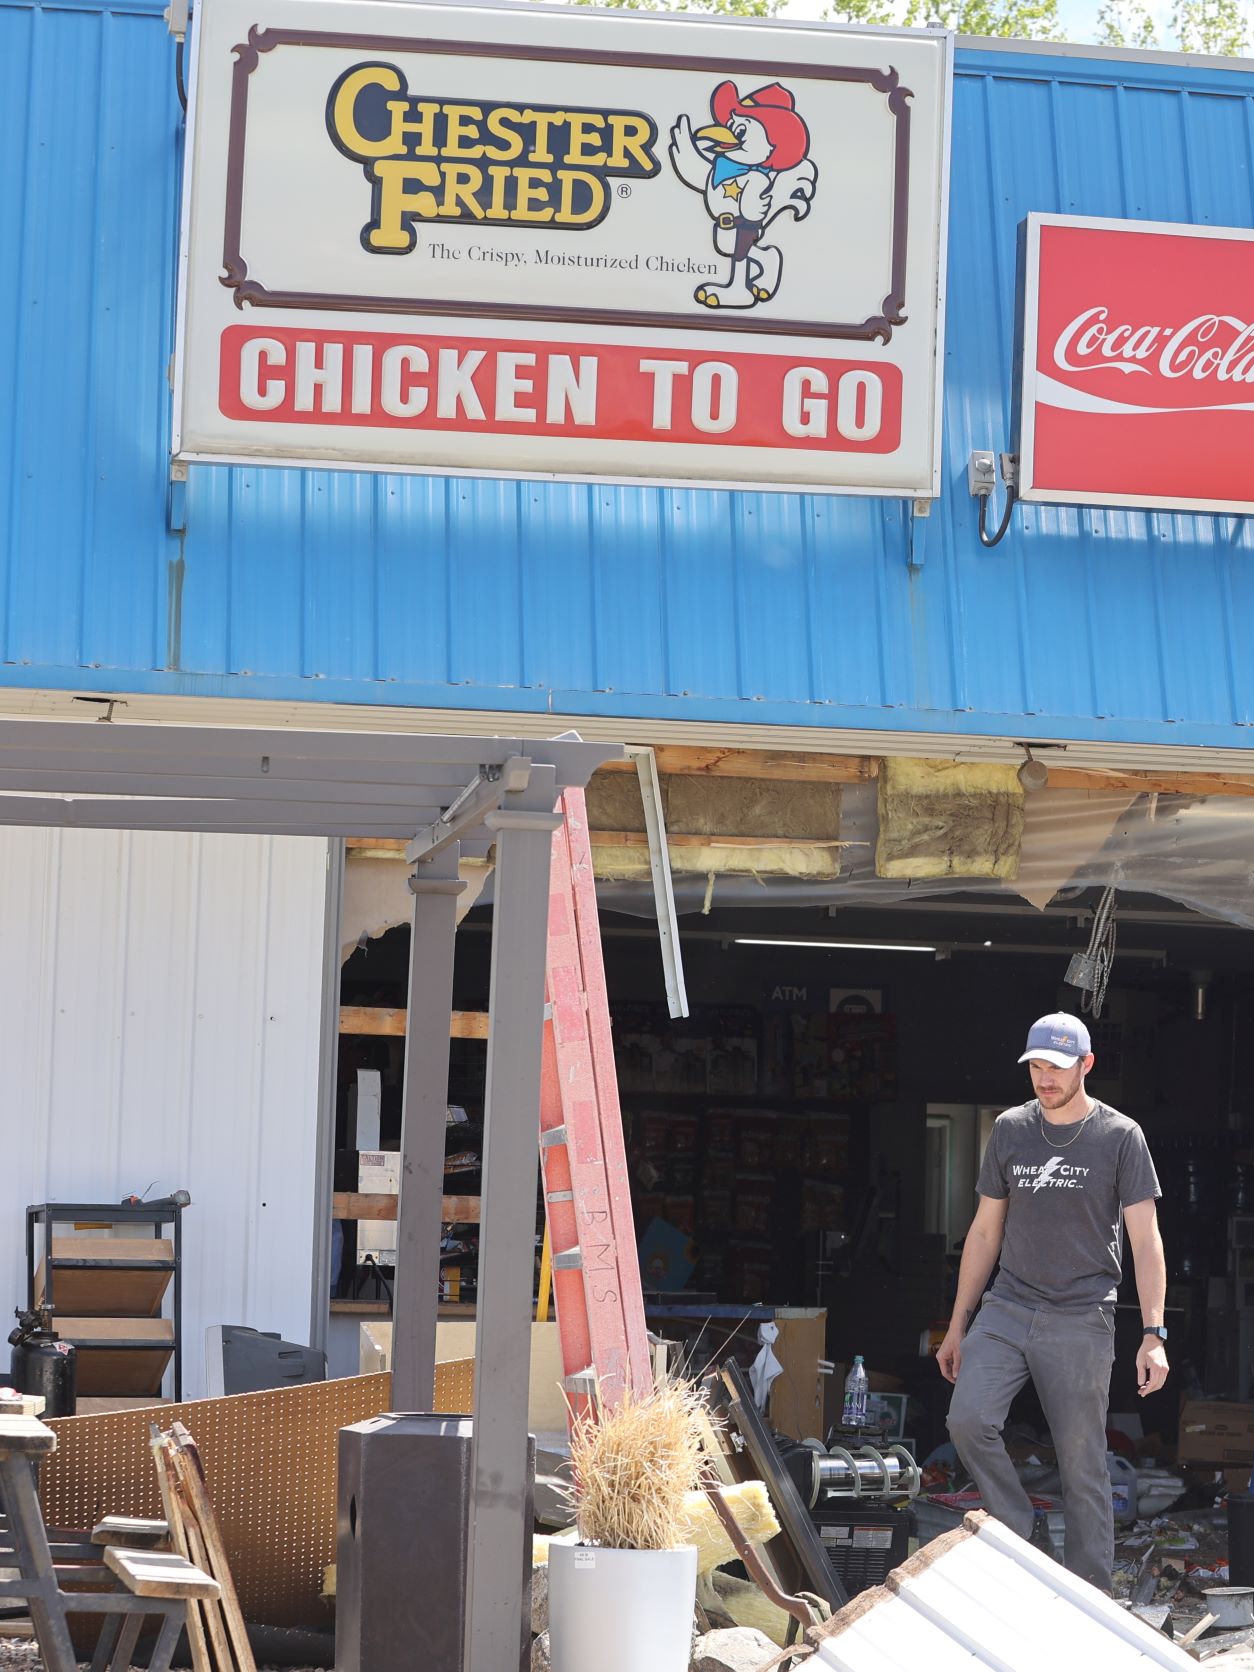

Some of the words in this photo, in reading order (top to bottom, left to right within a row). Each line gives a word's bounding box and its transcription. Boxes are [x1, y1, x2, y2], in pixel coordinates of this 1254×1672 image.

[334, 67, 653, 169] CHESTER
[428, 243, 461, 260] The
[467, 246, 528, 266] Crispy,
[534, 250, 639, 271] Moisturized
[645, 255, 718, 276] Chicken
[239, 337, 598, 426] CHICKEN
[640, 359, 738, 431] TO
[782, 367, 883, 440] GO
[771, 985, 807, 1001] ATM
[1060, 1164, 1090, 1177] CITY
[1017, 1178, 1077, 1189] ELECTRIC
